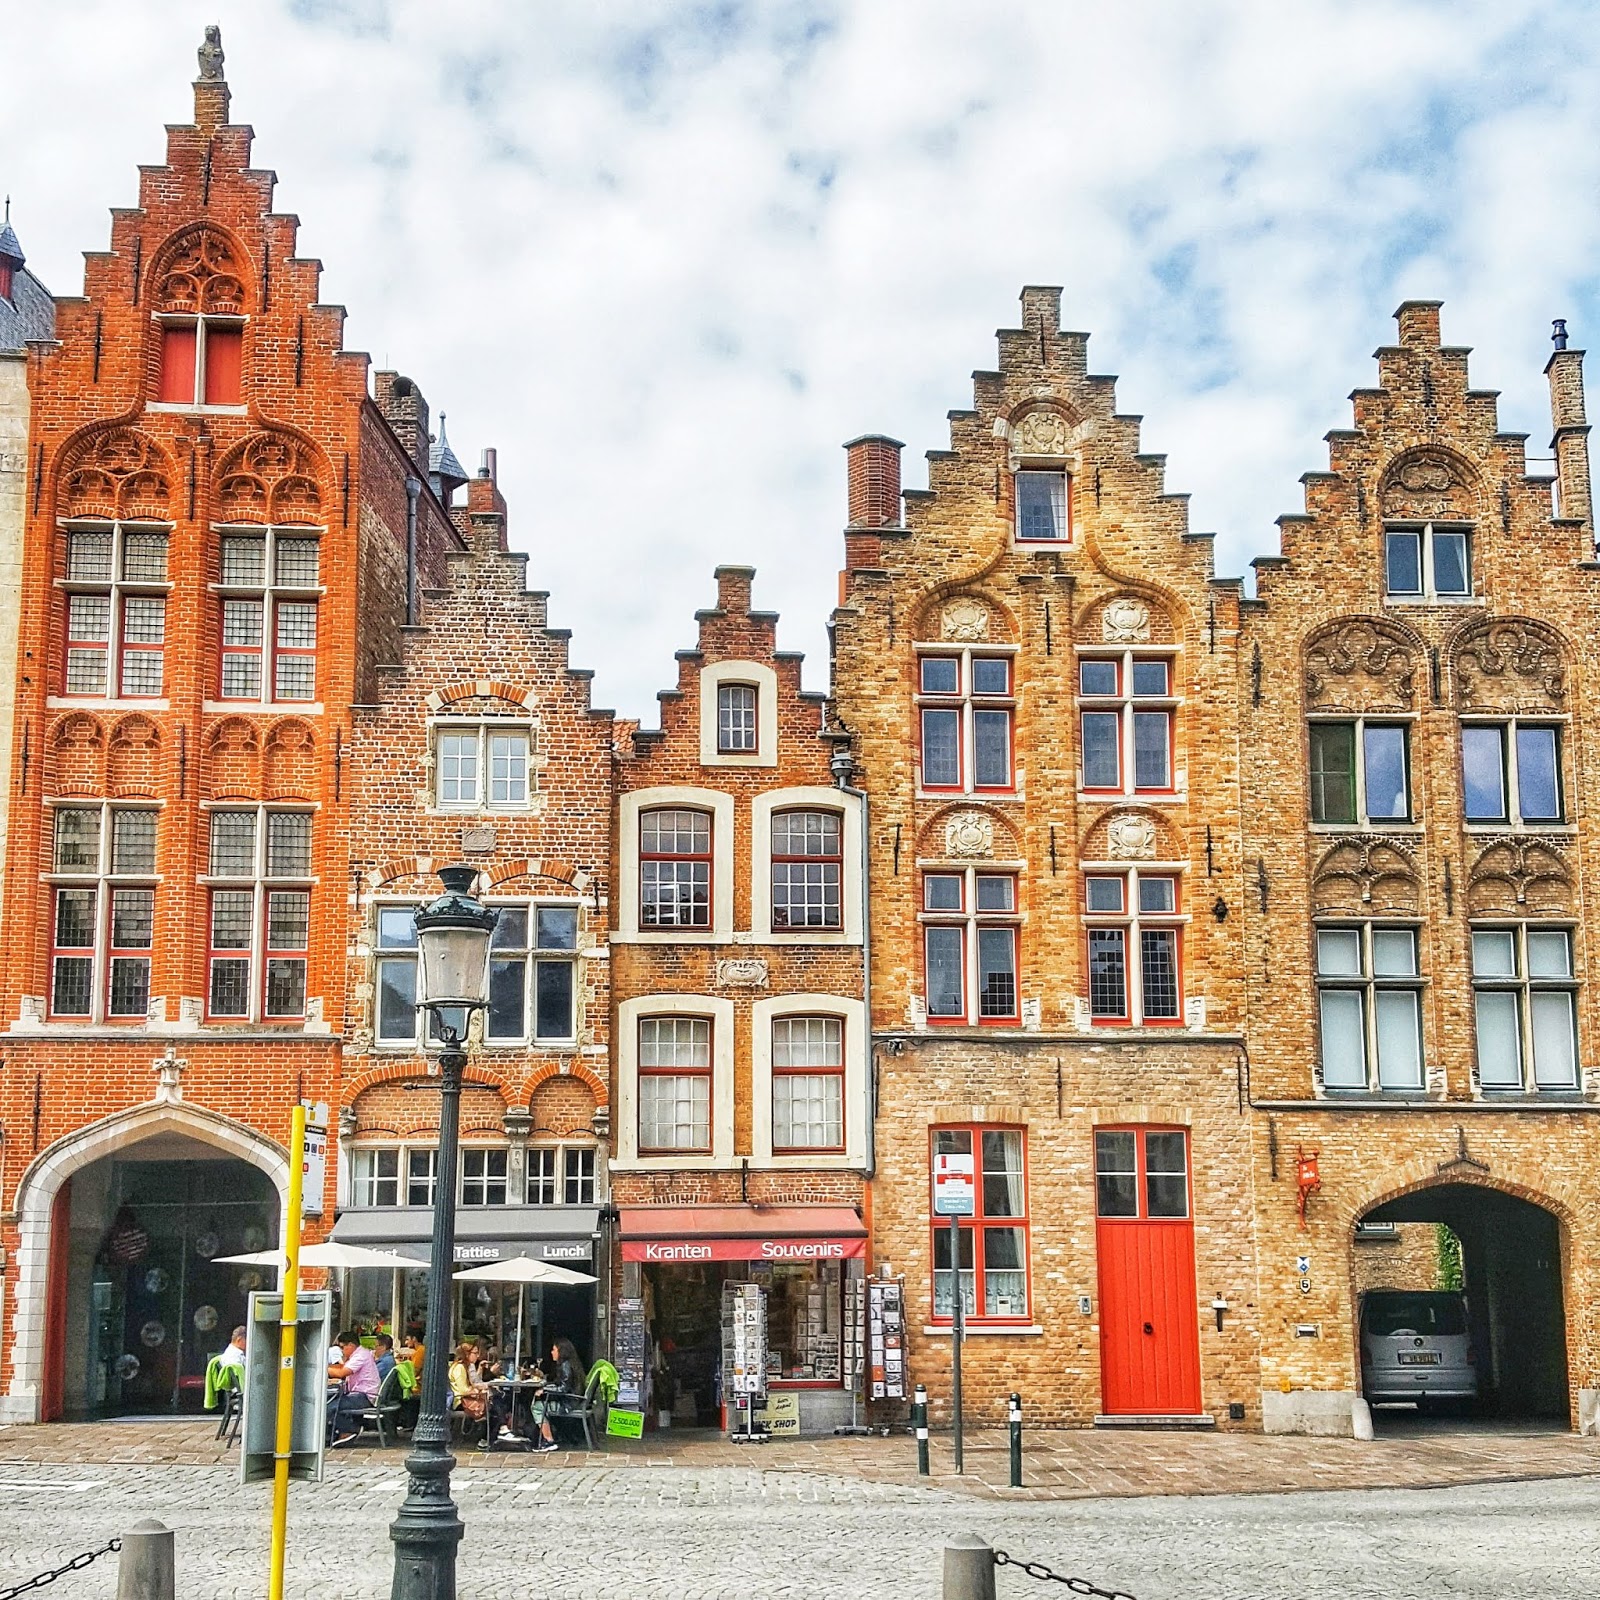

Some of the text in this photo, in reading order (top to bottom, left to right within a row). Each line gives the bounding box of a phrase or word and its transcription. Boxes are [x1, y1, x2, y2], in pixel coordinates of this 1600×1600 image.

[453, 1246, 500, 1258] Tatties
[543, 1245, 585, 1257] Lunch
[646, 1241, 844, 1259] Kranten Souvenirs
[1216, 1291, 1222, 1300] 5
[774, 1420, 797, 1428] SHOP
